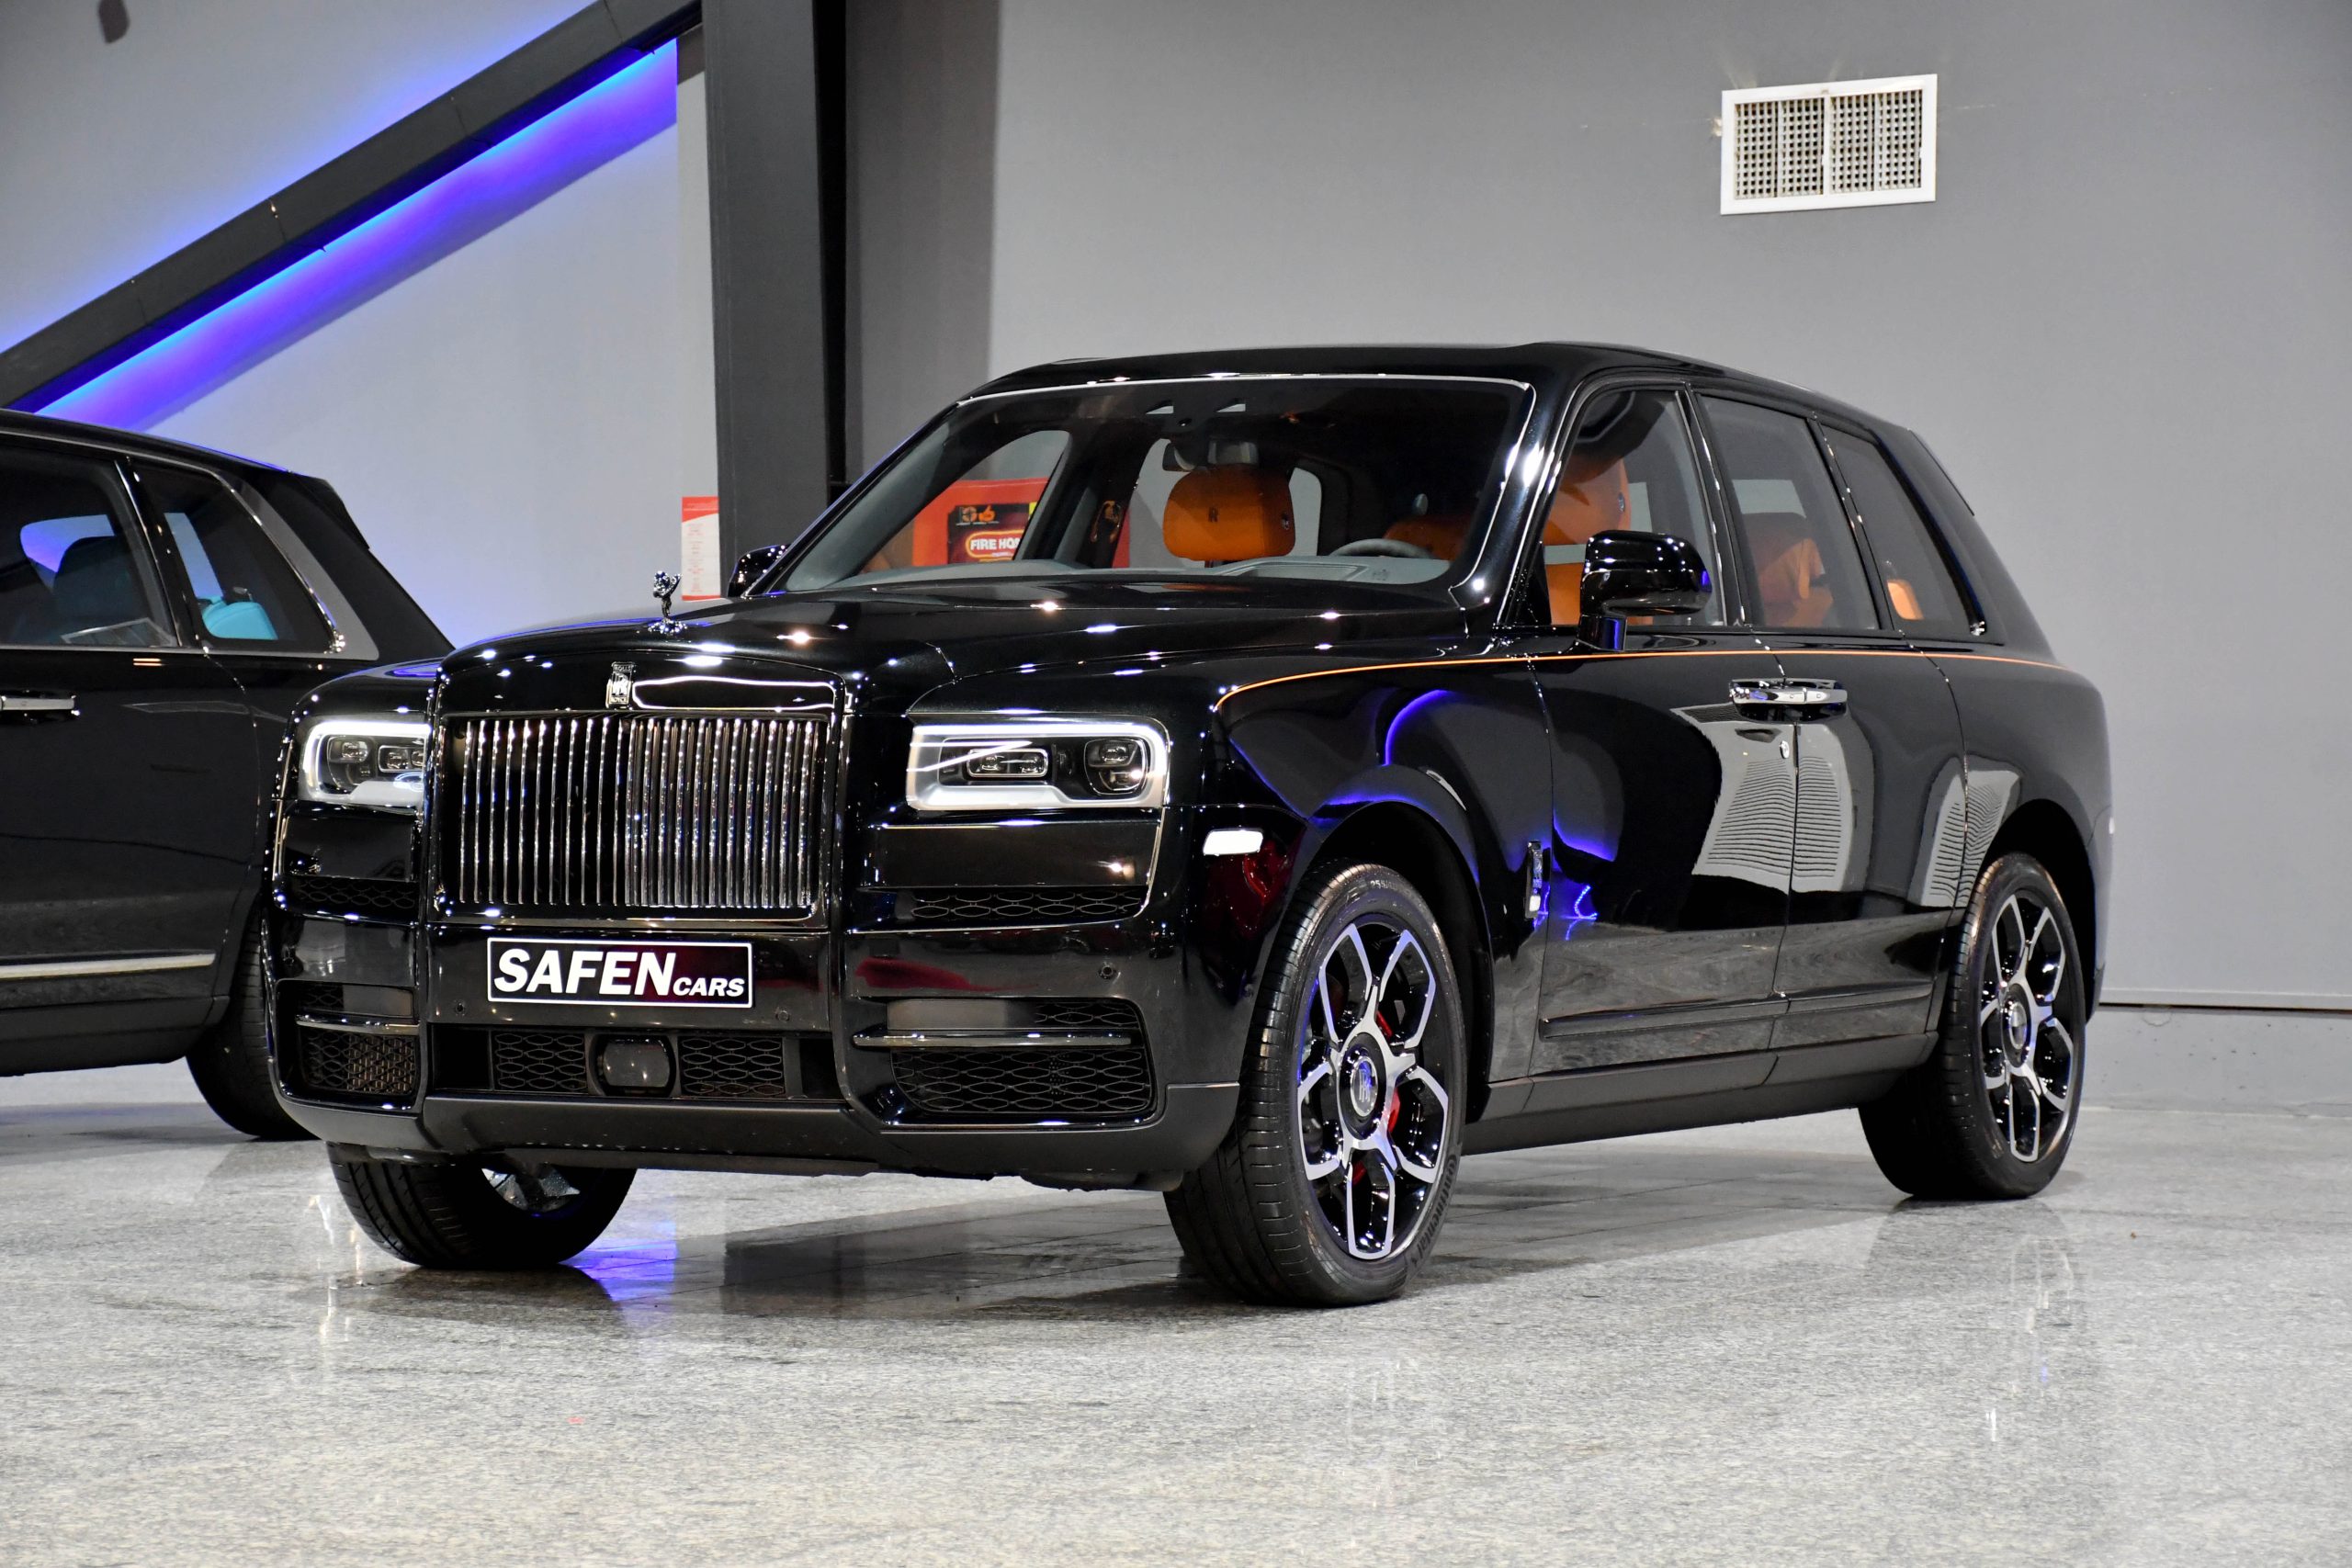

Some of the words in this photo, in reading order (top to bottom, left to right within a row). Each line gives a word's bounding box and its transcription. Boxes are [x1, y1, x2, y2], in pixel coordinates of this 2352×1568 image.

[970, 538, 997, 550] FIRE
[493, 948, 676, 996] SAFEN
[673, 977, 745, 997] CARS
